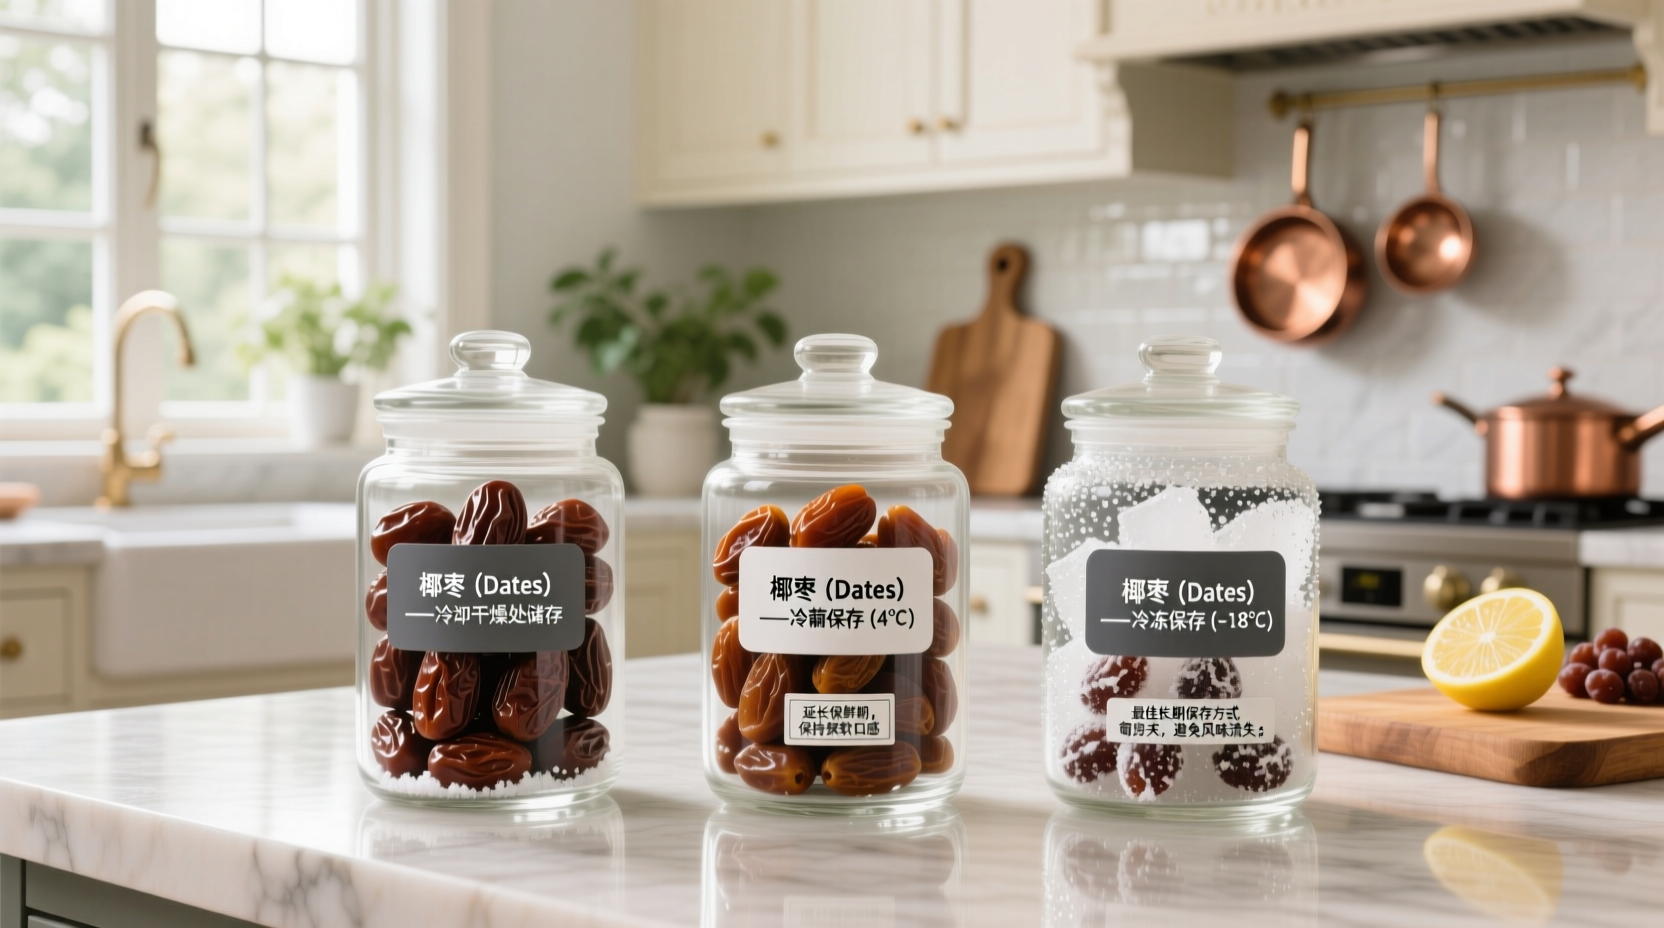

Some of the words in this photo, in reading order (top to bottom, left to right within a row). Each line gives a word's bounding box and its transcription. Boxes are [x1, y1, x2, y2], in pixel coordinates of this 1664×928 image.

[419, 572, 465, 598] 椰枣
[475, 572, 551, 598] (Dates)
[770, 575, 816, 601] 椰枣
[826, 576, 904, 601] (Dates)
[1122, 578, 1169, 604] 椰枣
[1179, 579, 1254, 605] (Dates)
